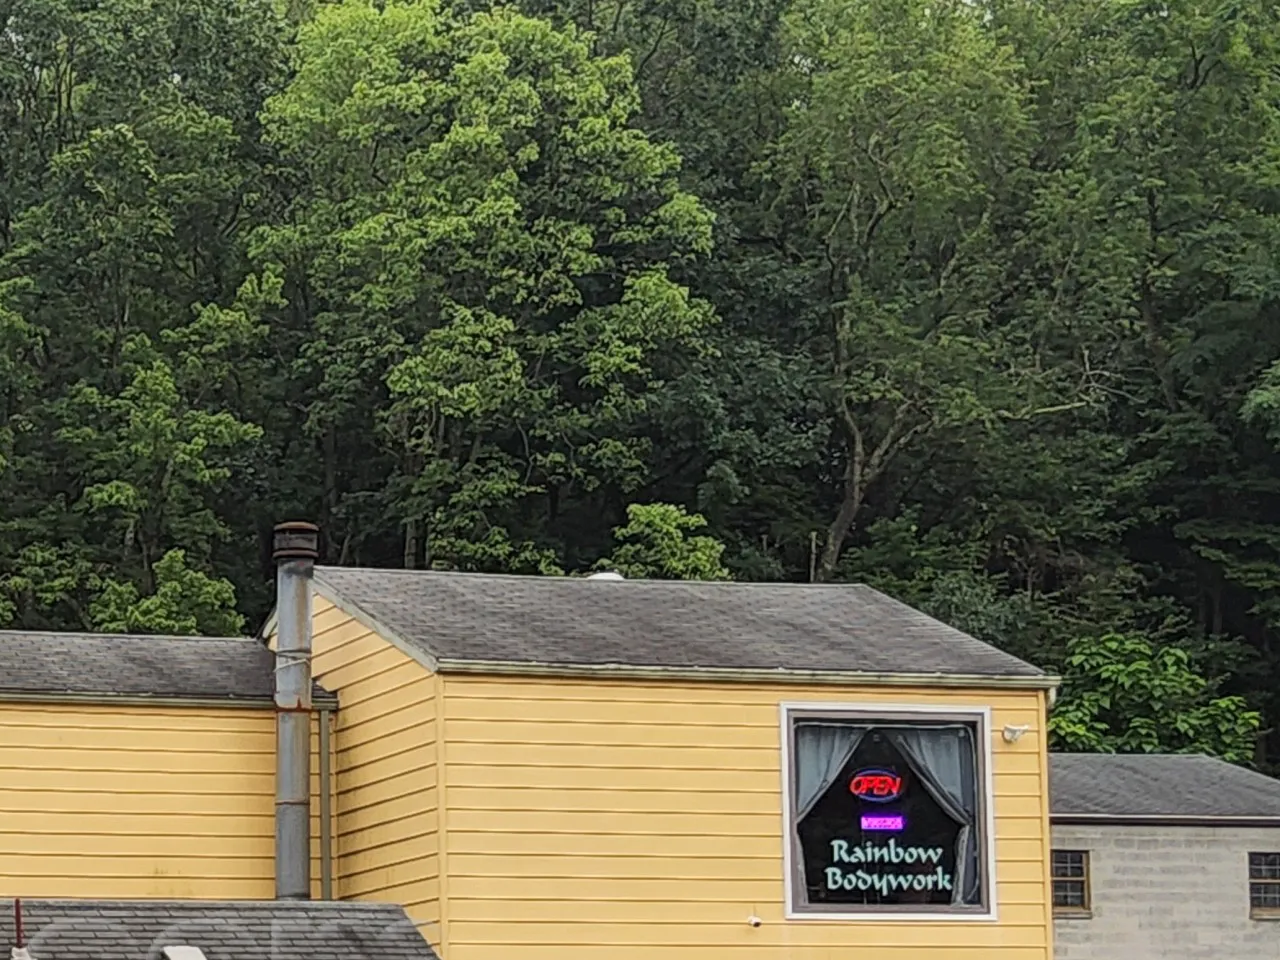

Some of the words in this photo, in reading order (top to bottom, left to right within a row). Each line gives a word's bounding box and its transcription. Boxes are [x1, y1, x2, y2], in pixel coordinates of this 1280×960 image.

[850, 775, 901, 796] OPEN
[830, 838, 943, 864] Rainbow
[824, 866, 953, 896] Bodywork
